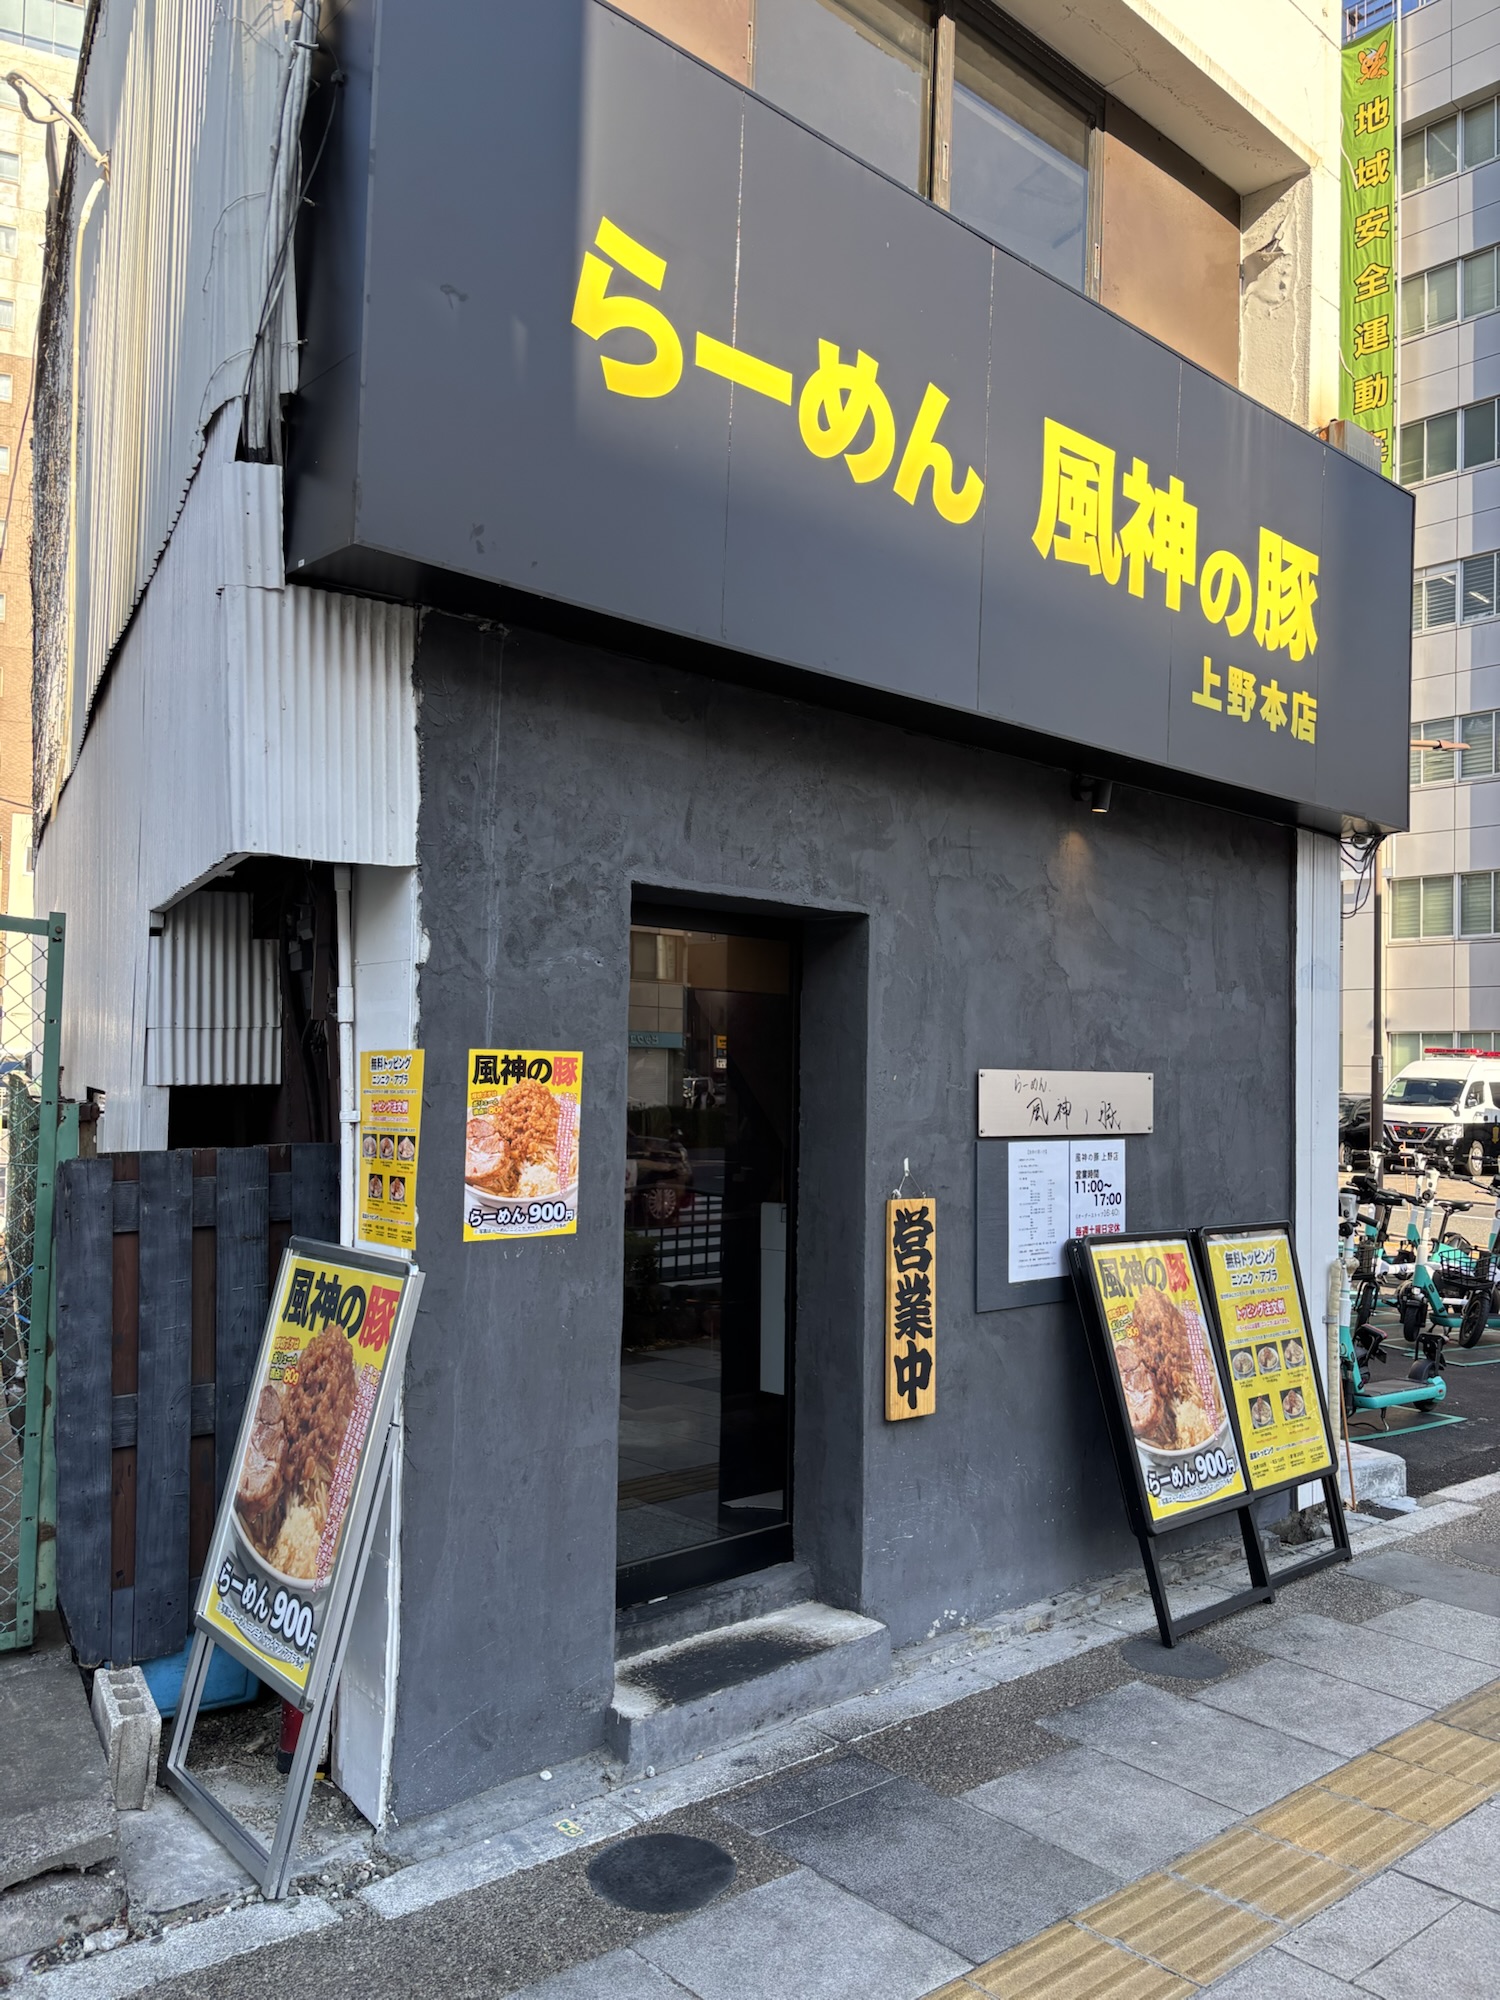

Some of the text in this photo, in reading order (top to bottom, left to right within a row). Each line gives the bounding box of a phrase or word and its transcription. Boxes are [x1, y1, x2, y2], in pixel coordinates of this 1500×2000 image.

[571, 217, 1320, 661] らーめん 風神の豚
[1192, 656, 1318, 744] 上野本店
[371, 1055, 412, 1071] 無料トッピング
[472, 1054, 578, 1086] 風神の豚
[372, 1074, 408, 1086] ニンニク・アブラ
[1101, 1151, 1119, 1161] 上野店
[1075, 1169, 1099, 1179] 営業時間
[1094, 1192, 1122, 1206] 17:00
[469, 1201, 574, 1228] らーめん 900円
[1224, 1246, 1276, 1270] 無料トッピング
[1098, 1253, 1190, 1299] 風神の豚
[1231, 1268, 1278, 1287] ニンニク・アブラ
[282, 1267, 401, 1352] 風神の豚
[893, 1206, 934, 1410] 営業中
[1235, 1297, 1286, 1321] トッピング注文例
[283, 1367, 300, 1387] 80g
[1147, 1460, 1196, 1497] らーめん
[1194, 1447, 1236, 1483] 900円
[217, 1556, 271, 1624] らーめん
